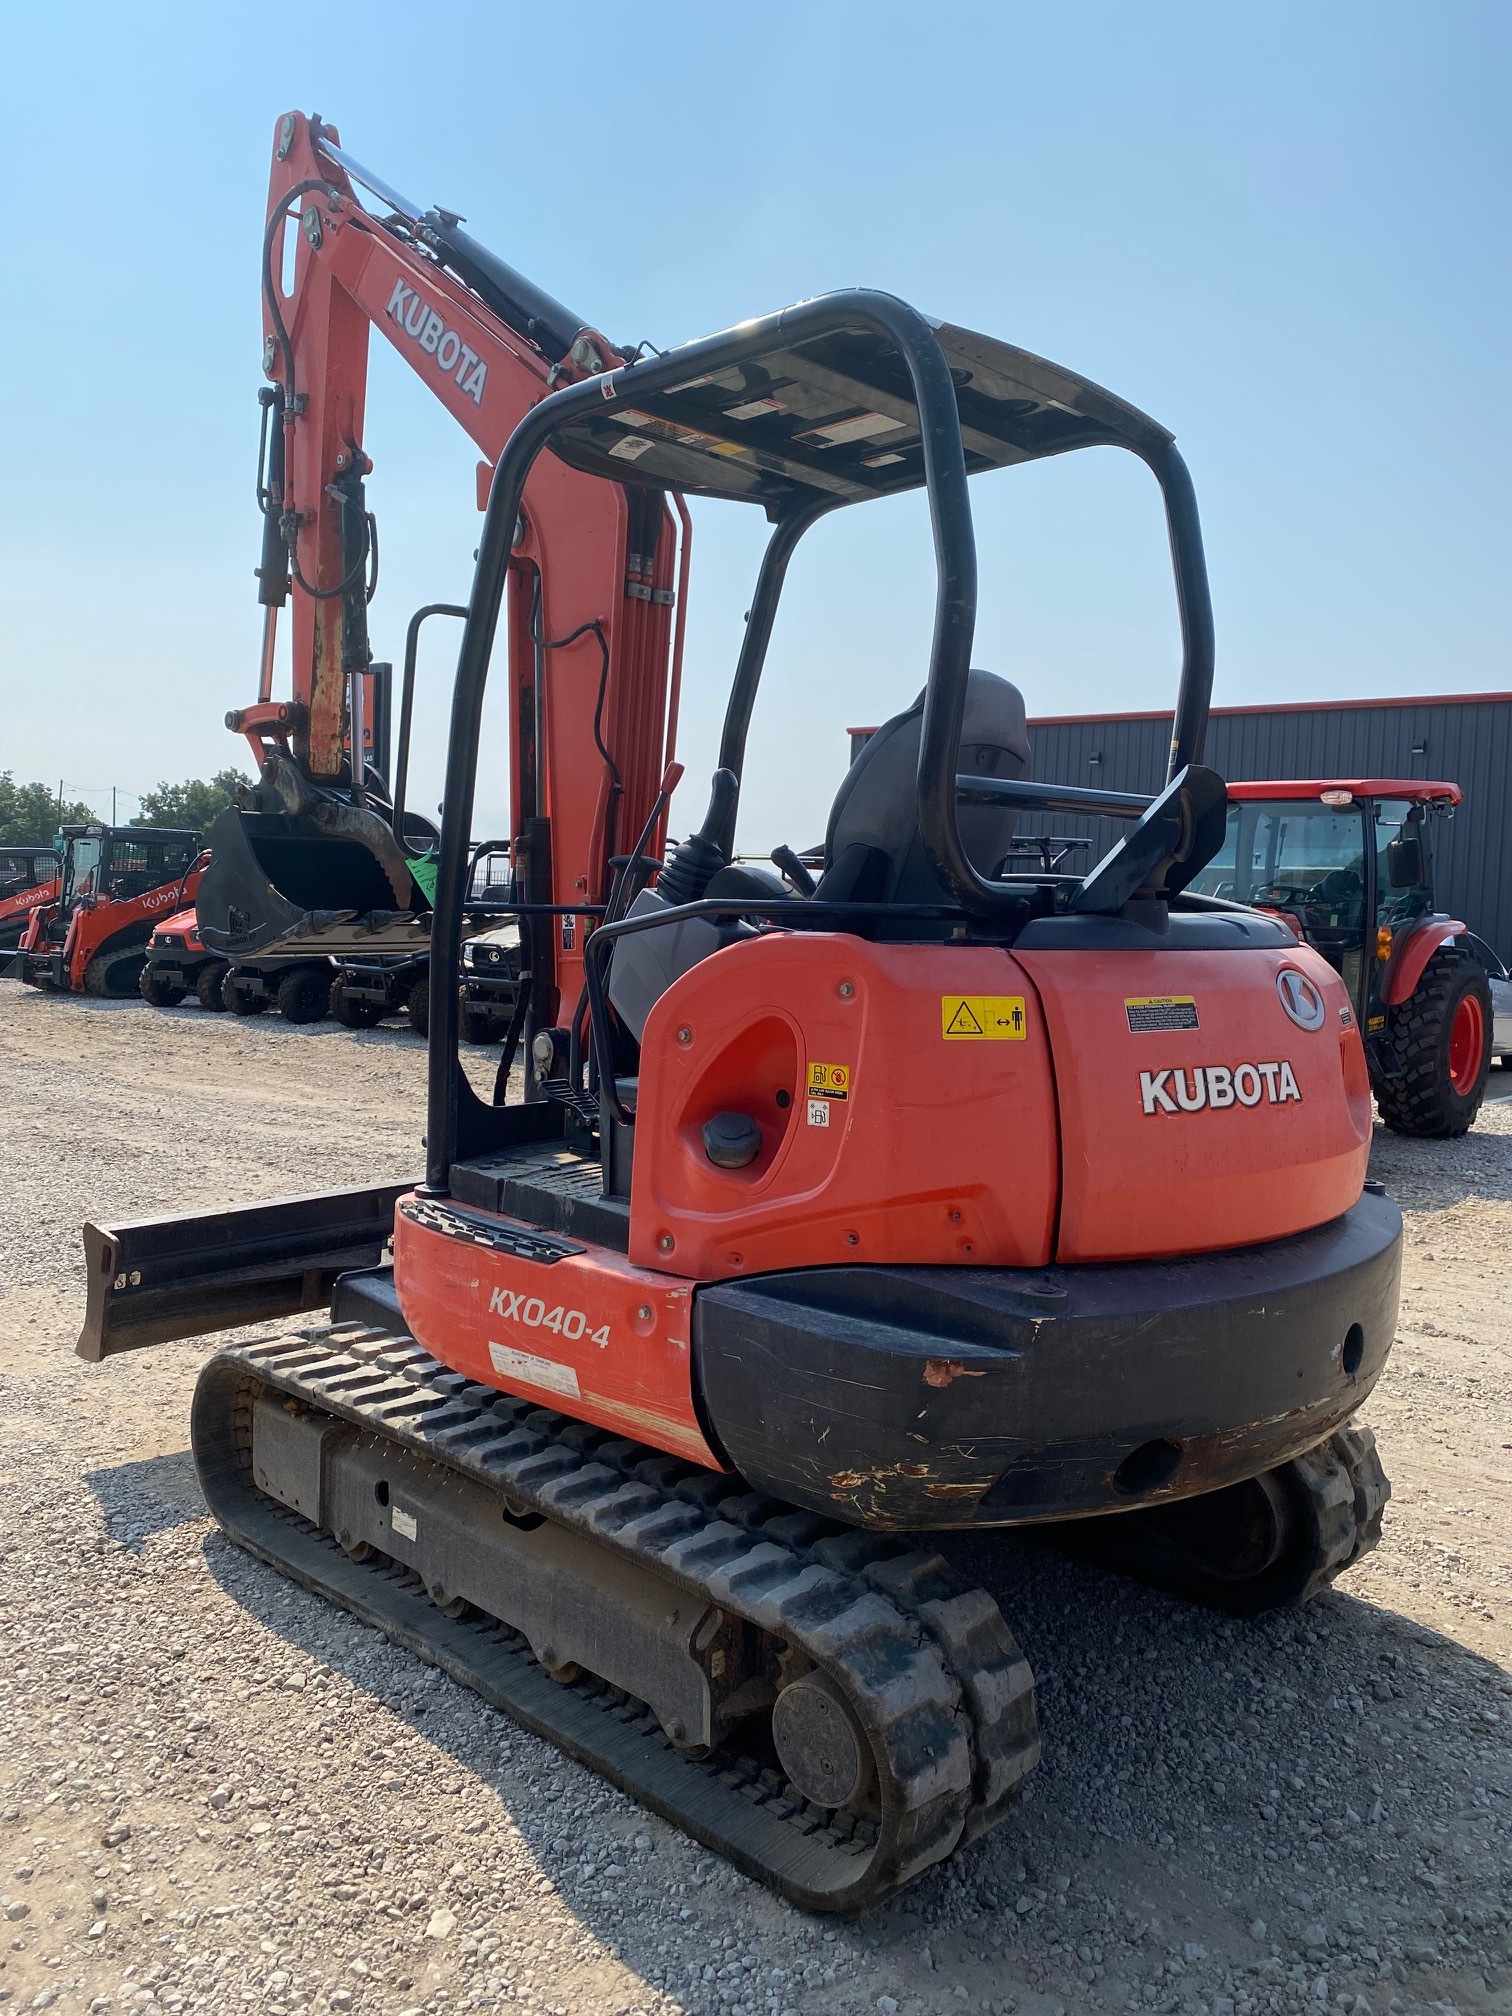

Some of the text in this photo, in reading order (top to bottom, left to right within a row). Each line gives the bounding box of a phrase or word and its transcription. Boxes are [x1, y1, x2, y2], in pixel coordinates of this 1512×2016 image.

[386, 277, 488, 405] KUBOTA
[15, 888, 50, 906] Kubota
[1139, 1060, 1303, 1115] KUBOTA
[488, 1286, 612, 1350] KX040-4
